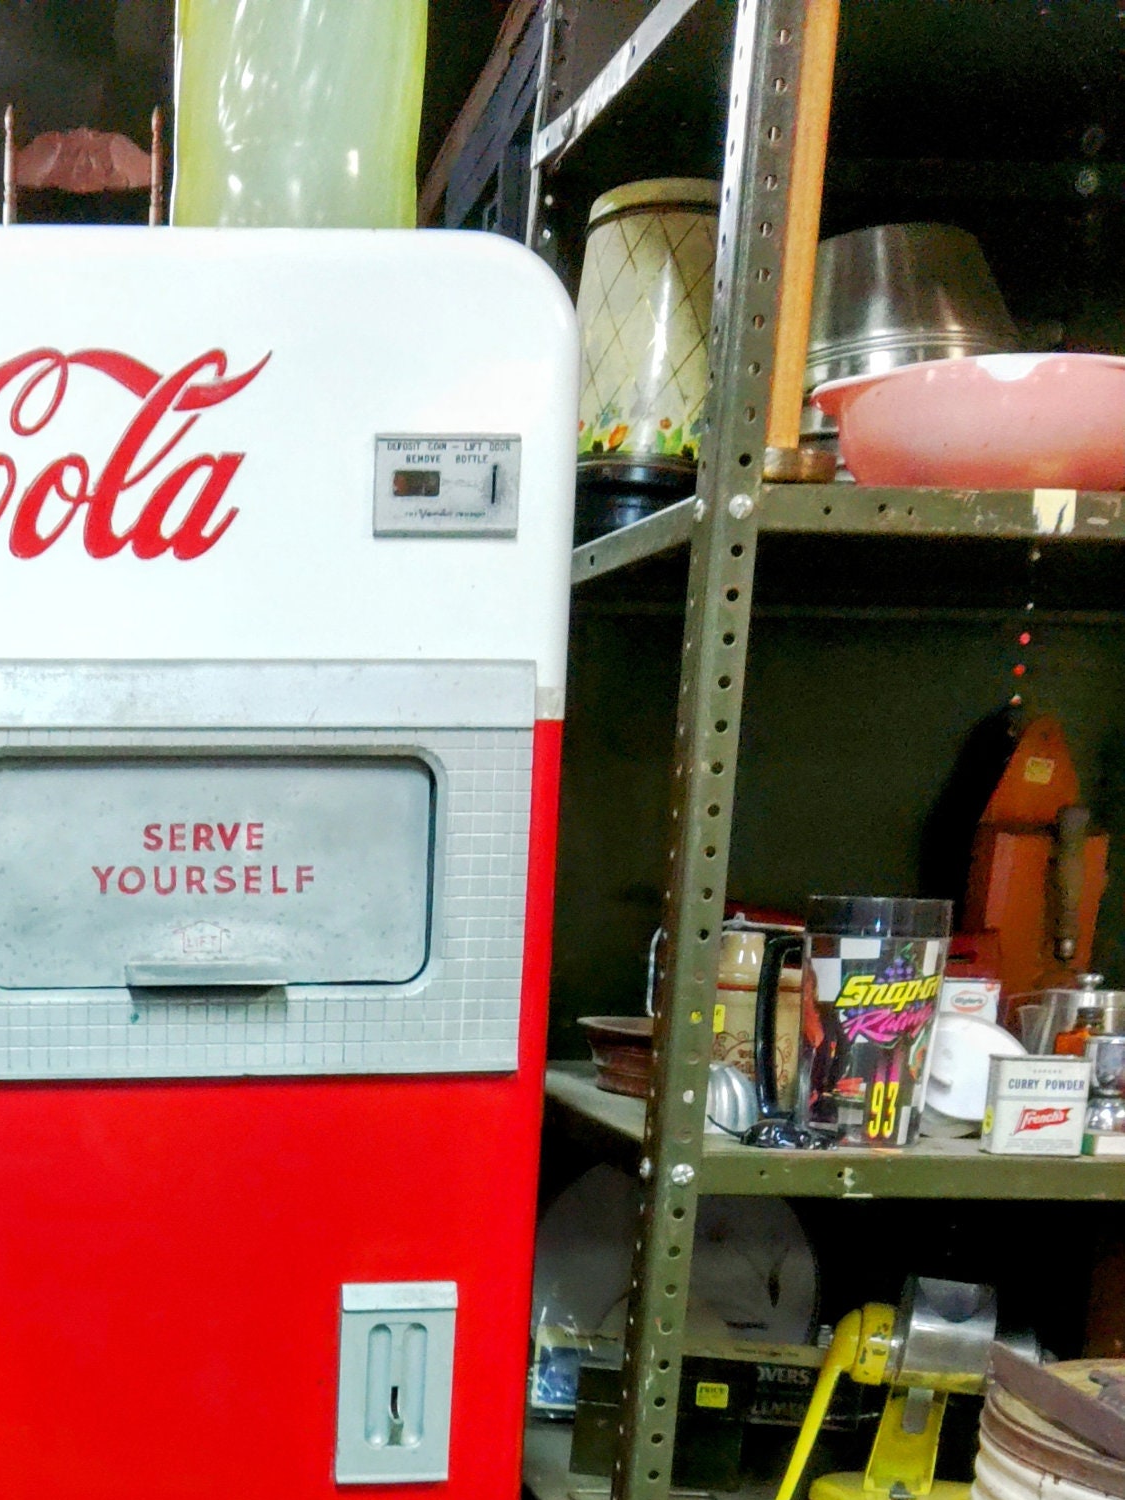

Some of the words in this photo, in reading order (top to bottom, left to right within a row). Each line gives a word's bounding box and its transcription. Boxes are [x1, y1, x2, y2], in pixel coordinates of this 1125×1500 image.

[387, 442, 421, 451] DEPOSIT
[428, 442, 447, 451] COIN
[464, 442, 482, 451] LIFT
[489, 442, 511, 451] DOOR
[406, 454, 441, 464] REMOVE
[455, 454, 488, 464] BOTTLE
[143, 822, 264, 851] SERVE
[91, 865, 315, 895] YOURSELF
[187, 936, 218, 948] LIFT
[1008, 1078, 1039, 1090] CURRY
[1045, 1079, 1086, 1091] POWDER
[868, 1081, 899, 1138] 93
